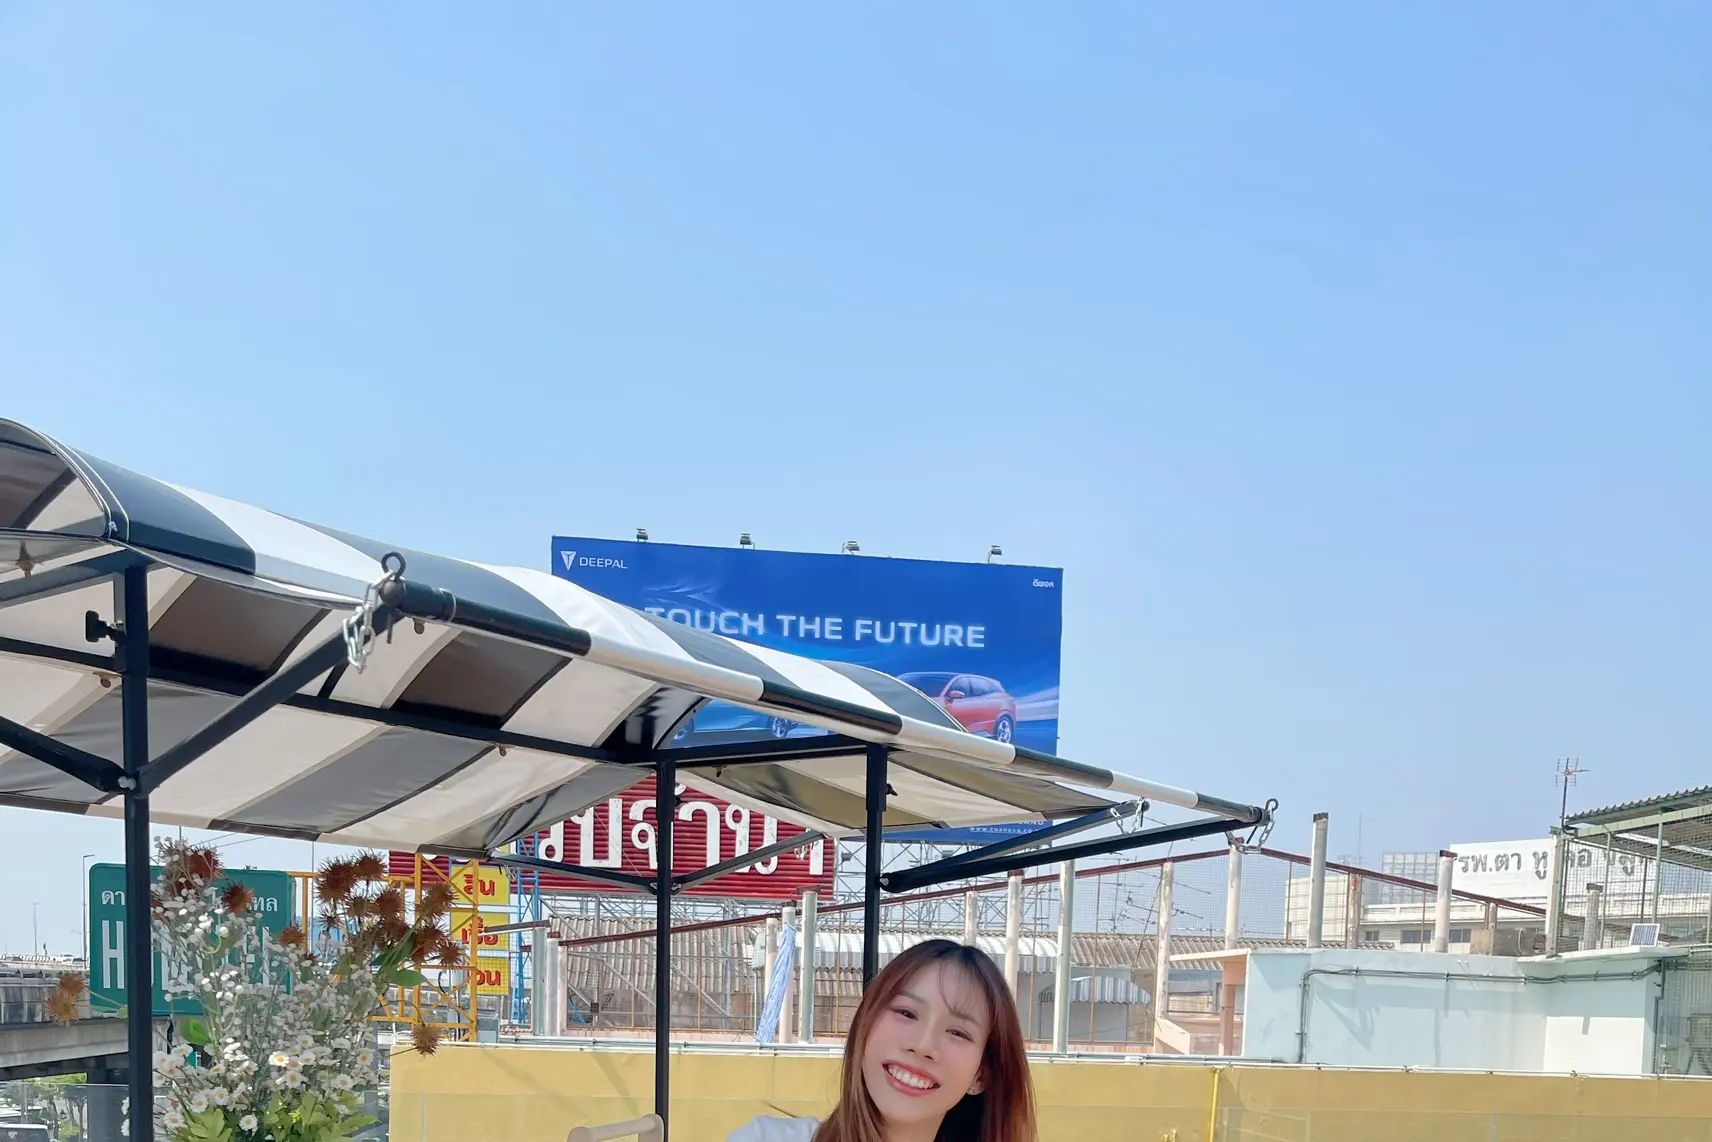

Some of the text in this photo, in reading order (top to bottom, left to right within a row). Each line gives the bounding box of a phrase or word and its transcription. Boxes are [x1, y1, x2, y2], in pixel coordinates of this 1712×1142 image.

[580, 557, 628, 569] DEEPAL
[644, 607, 985, 648] TOUCH THE FUTURE
